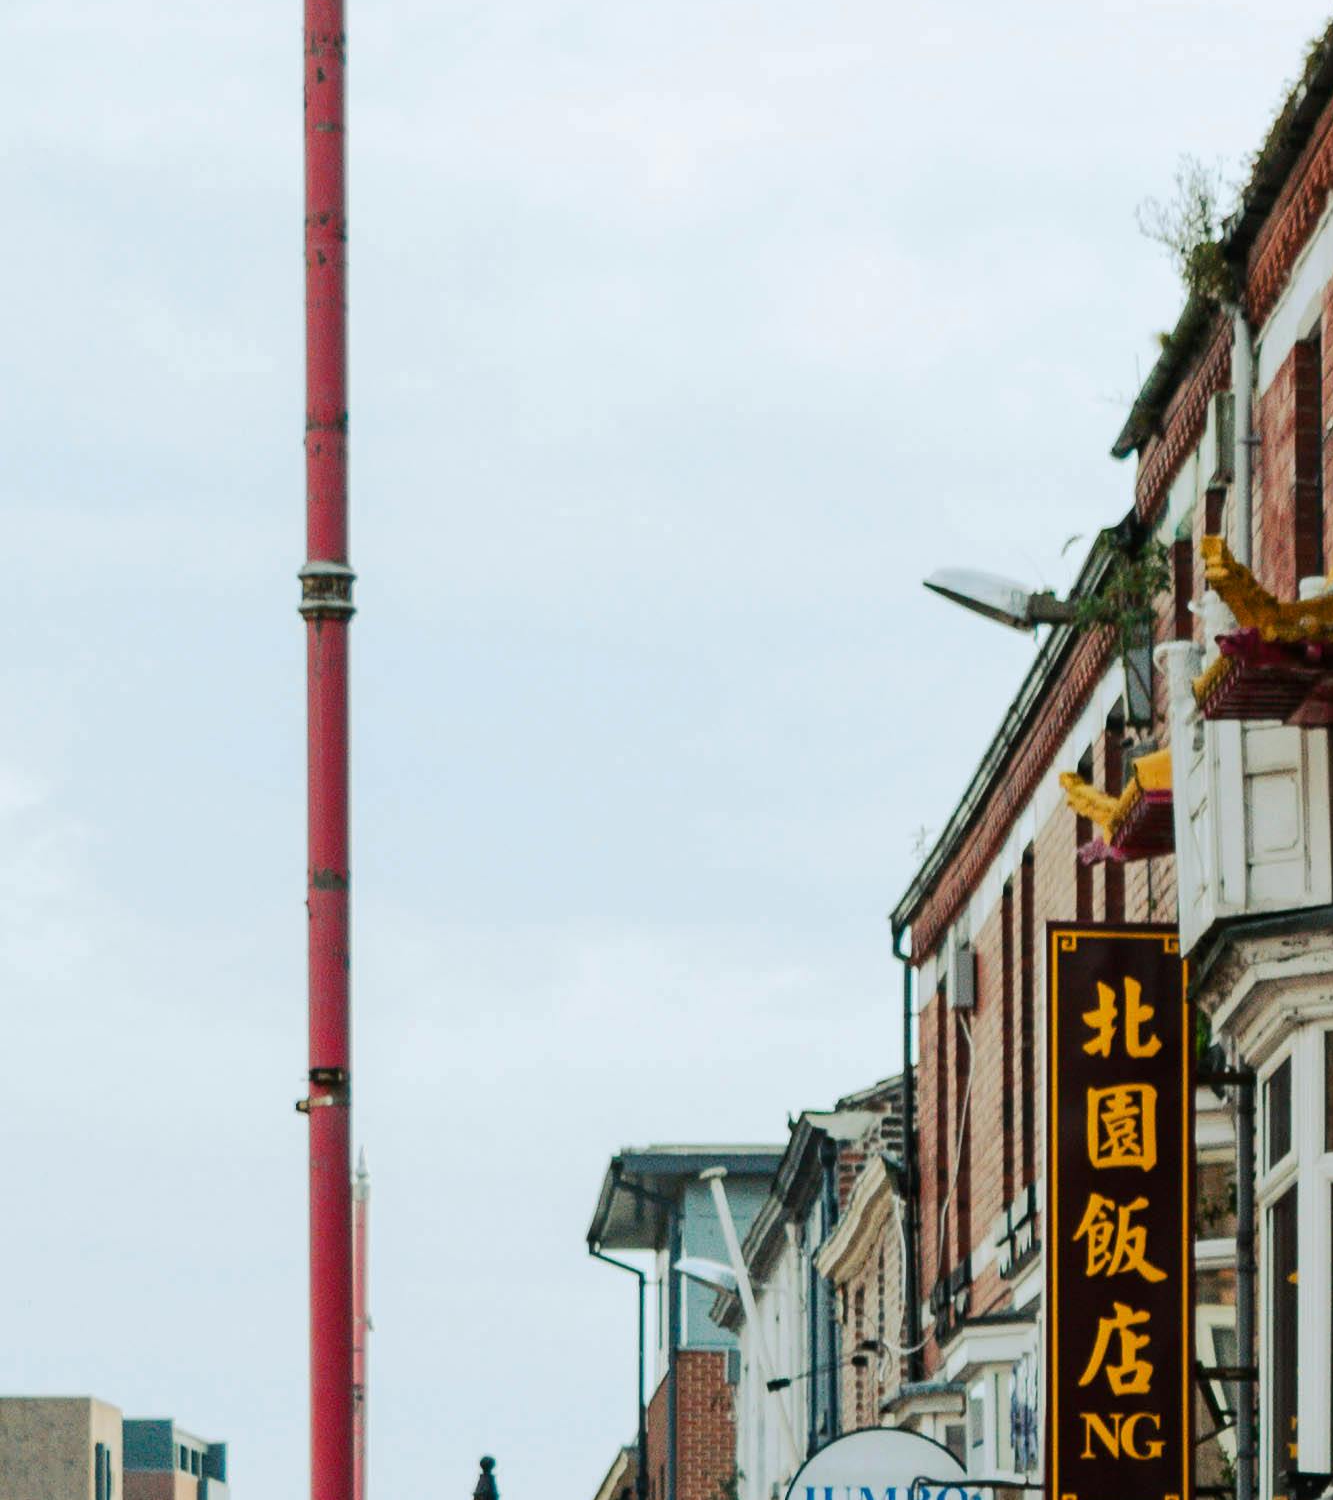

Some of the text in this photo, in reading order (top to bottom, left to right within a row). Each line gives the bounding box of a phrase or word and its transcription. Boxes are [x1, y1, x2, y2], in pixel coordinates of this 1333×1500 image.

[1071, 975, 1169, 1397] 北園飯店
[1080, 1412, 1166, 1460] NG
